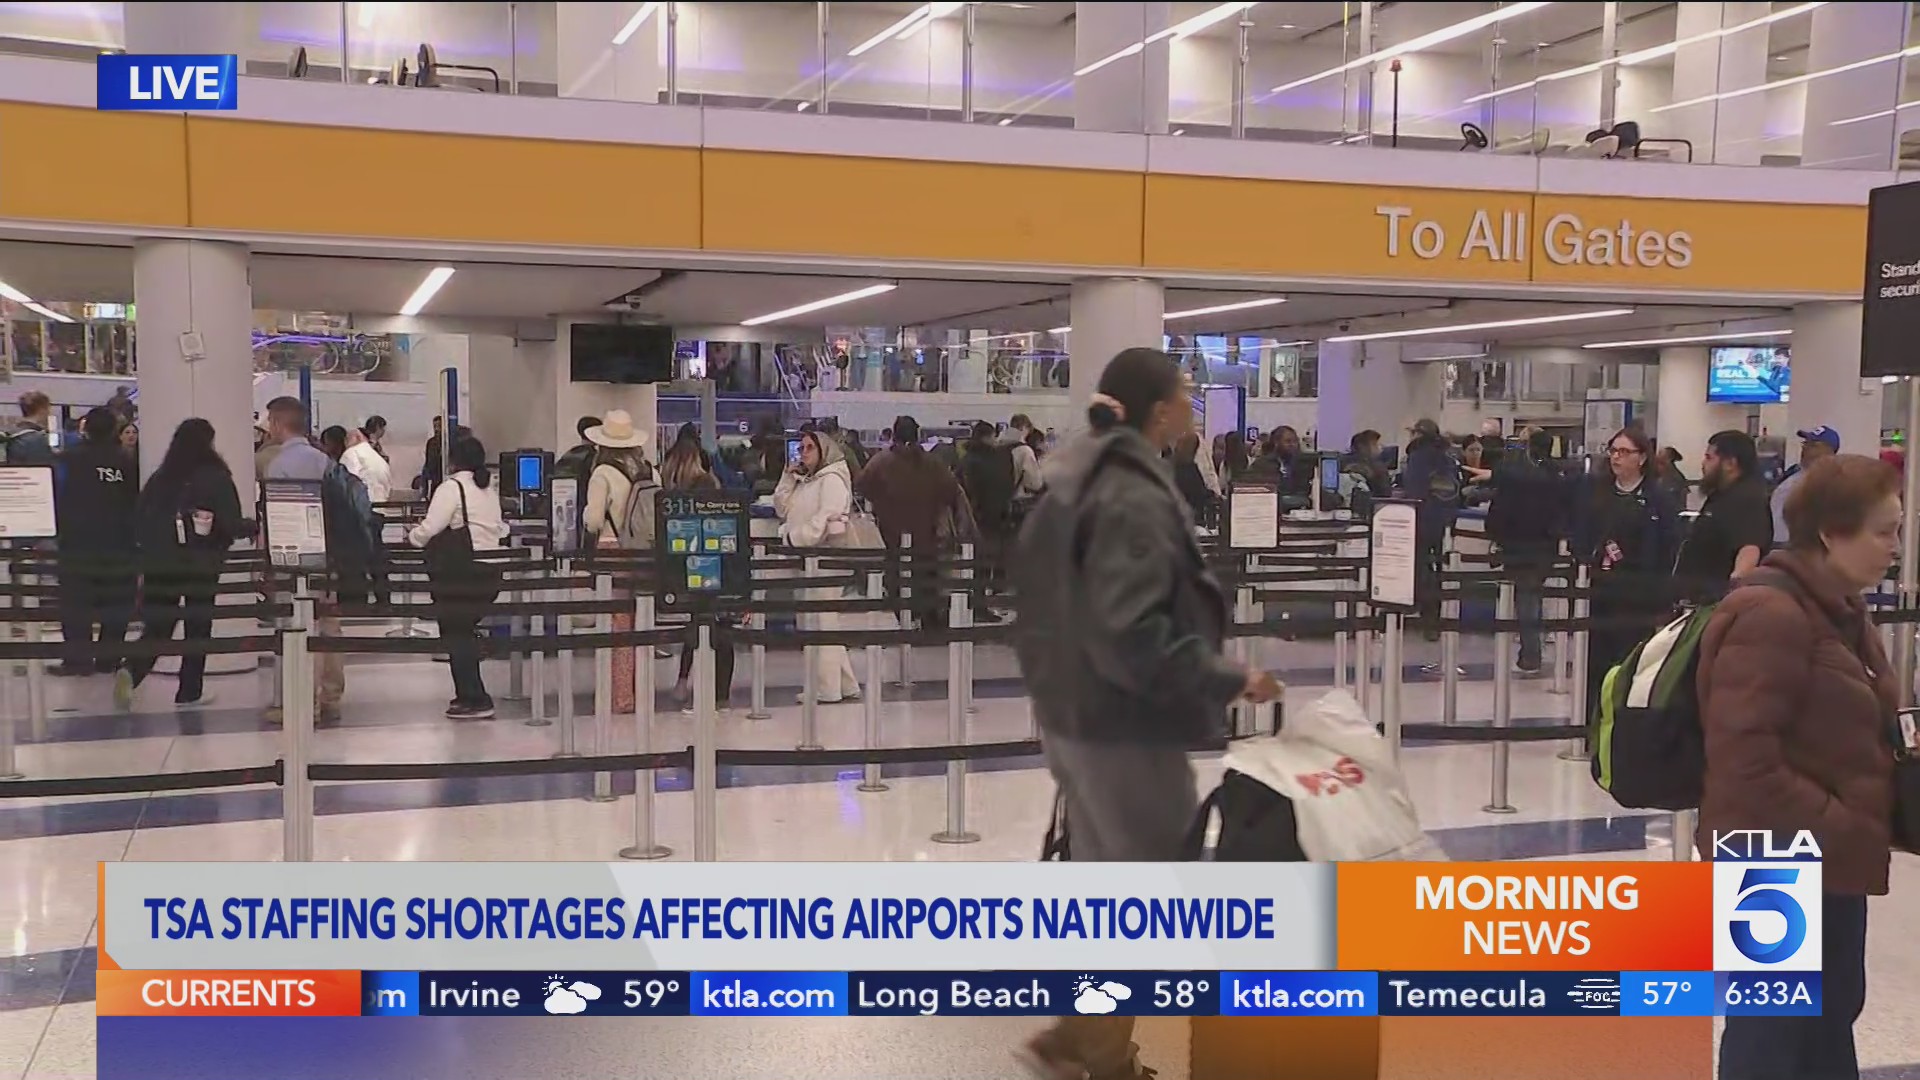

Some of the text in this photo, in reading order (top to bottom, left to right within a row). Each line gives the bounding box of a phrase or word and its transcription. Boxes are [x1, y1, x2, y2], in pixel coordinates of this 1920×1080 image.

[1376, 206, 1693, 268] To All Gates
[96, 467, 124, 482] TSA
